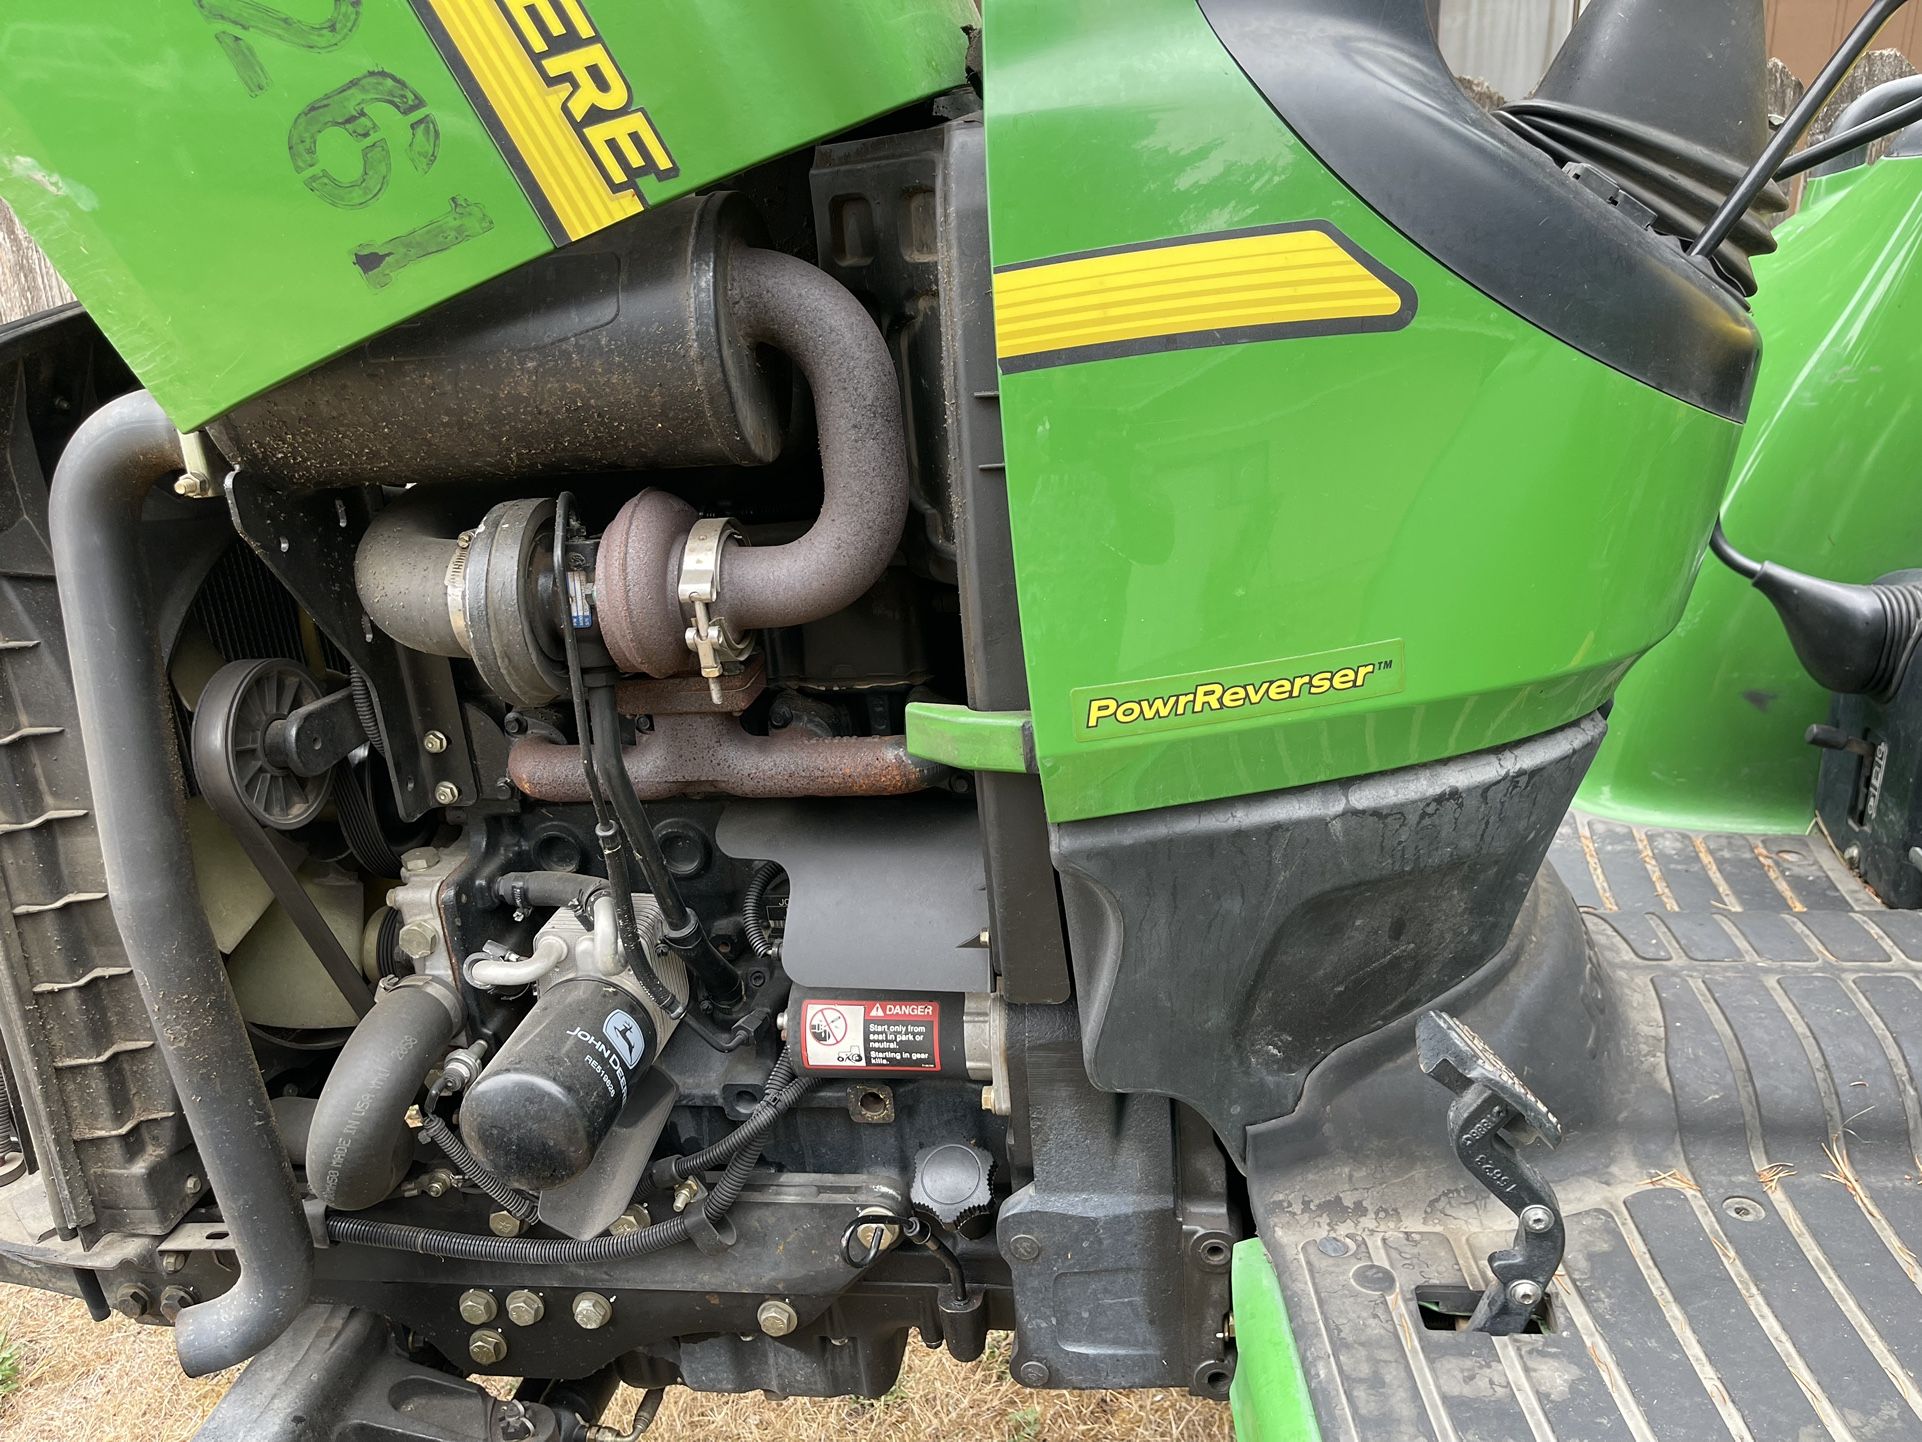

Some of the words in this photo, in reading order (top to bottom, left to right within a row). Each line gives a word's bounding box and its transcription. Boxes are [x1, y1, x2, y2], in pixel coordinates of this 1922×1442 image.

[885, 1004, 933, 1016] DANGER
[869, 1023, 888, 1032] Start
[889, 1024, 907, 1034] only
[908, 1024, 926, 1033] from
[566, 1026, 611, 1058] JOHN
[869, 1033, 886, 1041] seat
[888, 1033, 895, 1041] in
[896, 1033, 914, 1042] park
[869, 1041, 899, 1049] neutral.
[870, 1051, 901, 1059] Starting
[902, 1051, 910, 1059] in
[911, 1052, 929, 1060] gear
[352, 1093, 376, 1119] USA
[344, 1119, 361, 1135] IN
[331, 1137, 352, 1169] MADE
